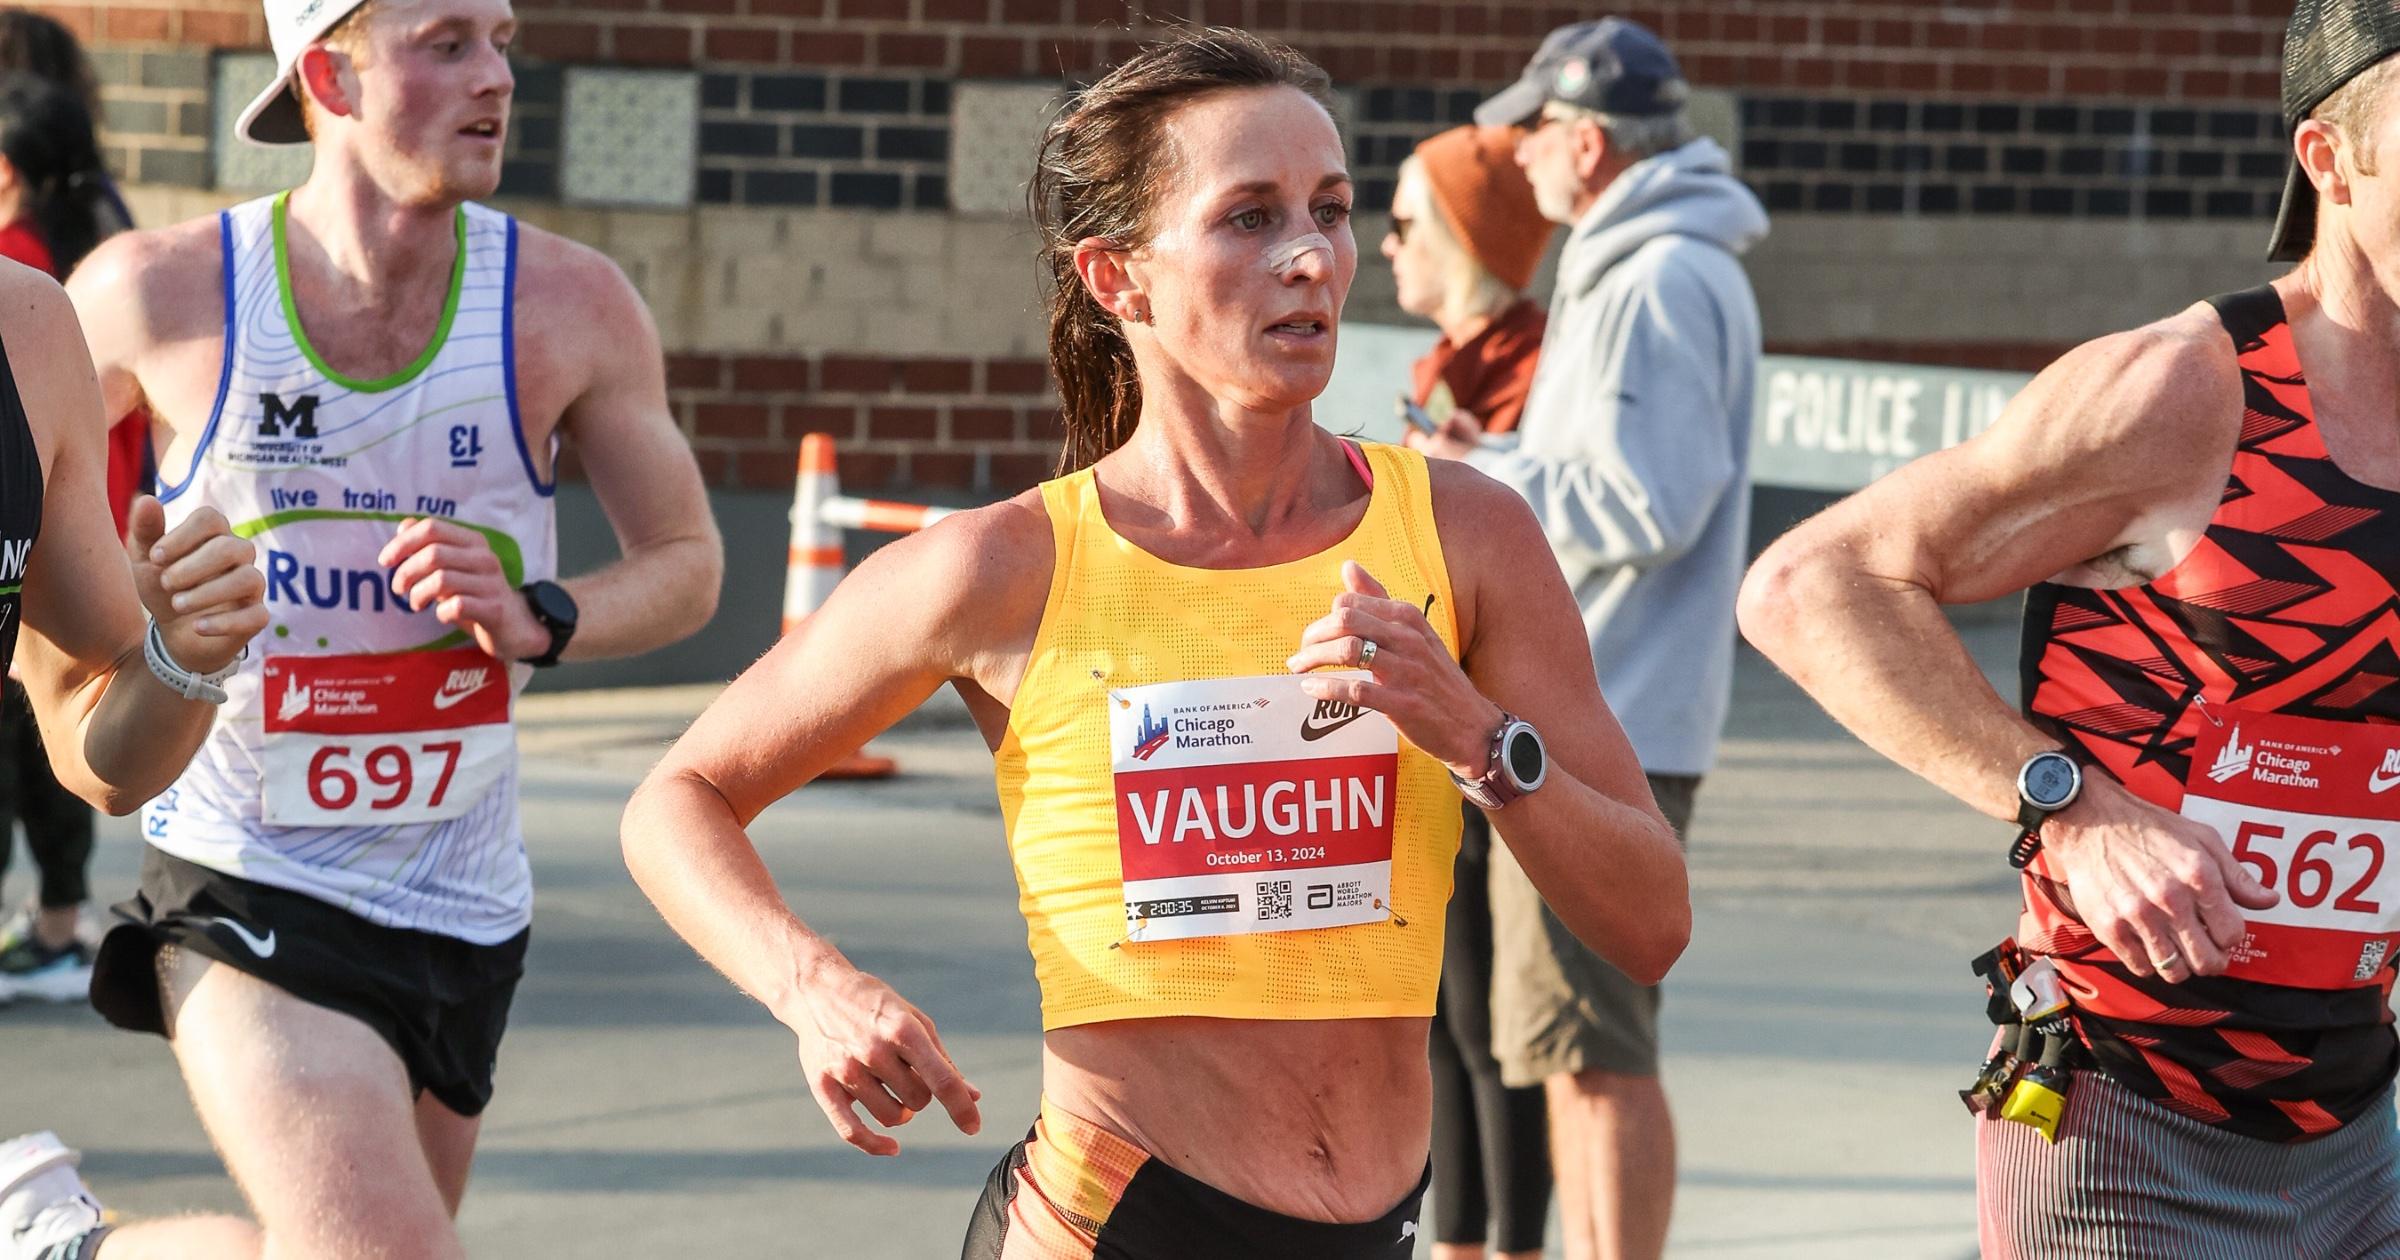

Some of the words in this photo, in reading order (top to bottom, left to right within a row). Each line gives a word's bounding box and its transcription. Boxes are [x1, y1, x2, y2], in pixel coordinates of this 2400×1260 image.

[258, 393, 319, 438] M
[1765, 371, 1921, 457] POLICE
[271, 487, 318, 509] live
[343, 488, 396, 510] train
[416, 495, 456, 517] run
[446, 667, 488, 691] RUN
[314, 688, 366, 706] Chicago
[314, 702, 378, 716] Marathon
[1173, 706, 1198, 714] BANK
[1212, 702, 1252, 712] AMERICA
[1174, 717, 1235, 733] Chicago
[2260, 739, 2283, 750] BANK
[2284, 743, 2295, 751] OF
[2295, 745, 2328, 755] AMERICA
[2256, 751, 2310, 774] Chicago
[306, 741, 463, 811] 697
[2252, 767, 2319, 789] Marathon
[1127, 775, 1385, 845] VAUGHN
[1206, 849, 1262, 867] October
[1266, 849, 1287, 864] 13,
[1291, 846, 1326, 862] 2024
[2232, 820, 2385, 914] 562
[1337, 881, 1361, 889] ABBOTT
[1337, 887, 1359, 895] WORLD
[1337, 892, 1372, 901] MARATHON
[1337, 900, 1363, 908] MAJORS
[1150, 900, 1194, 916] 2:00:35
